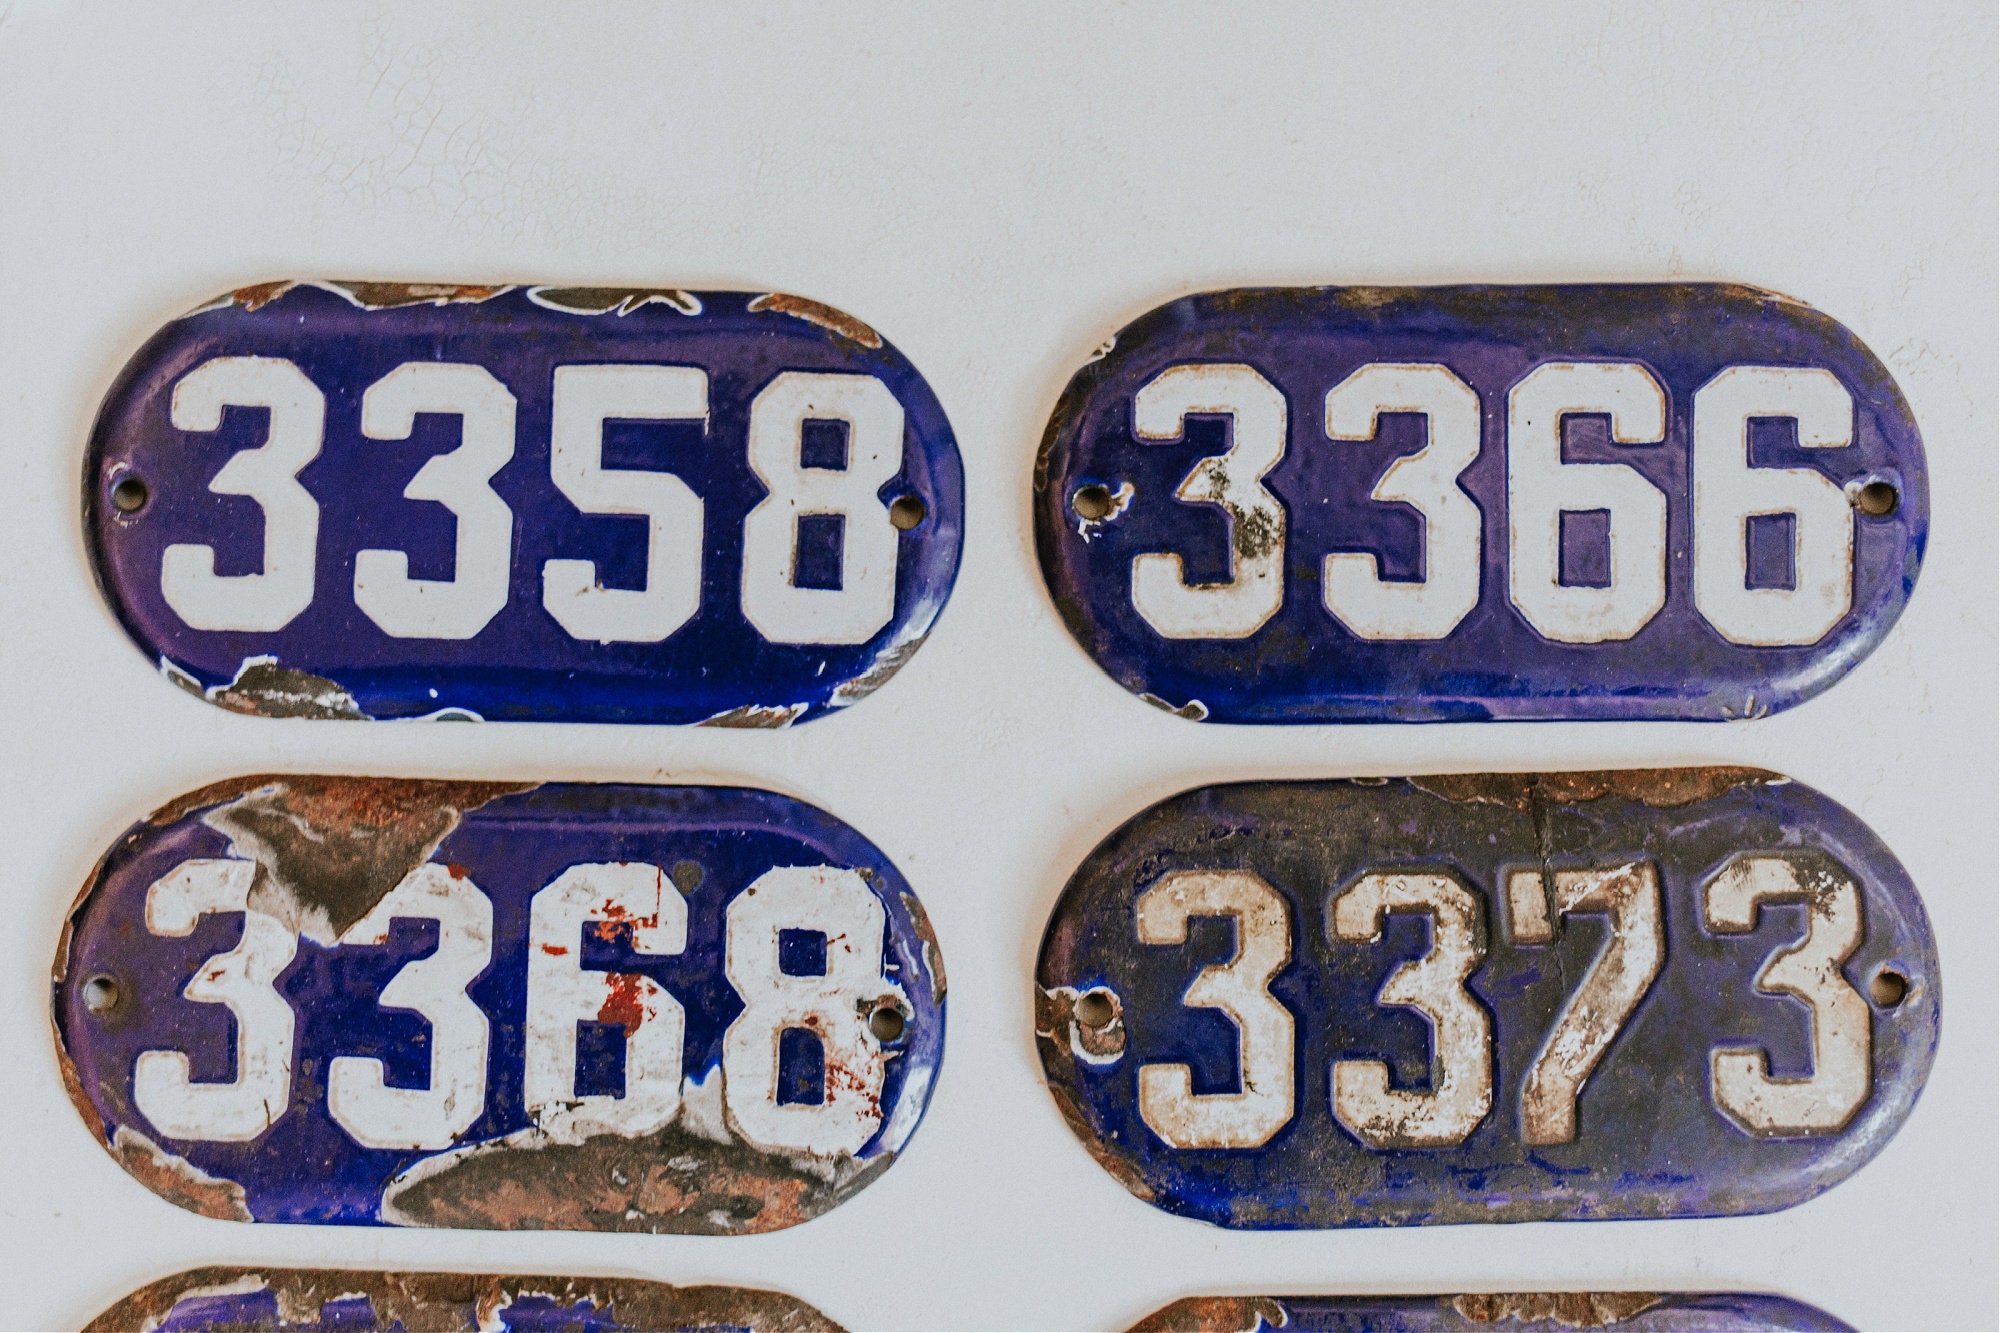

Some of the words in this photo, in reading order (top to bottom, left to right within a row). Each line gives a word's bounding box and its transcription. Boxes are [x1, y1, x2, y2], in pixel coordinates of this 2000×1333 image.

[161, 355, 906, 646] 3358
[1130, 361, 1854, 647] 3366
[133, 857, 886, 1156] 3368
[1136, 855, 1872, 1149] 3373
